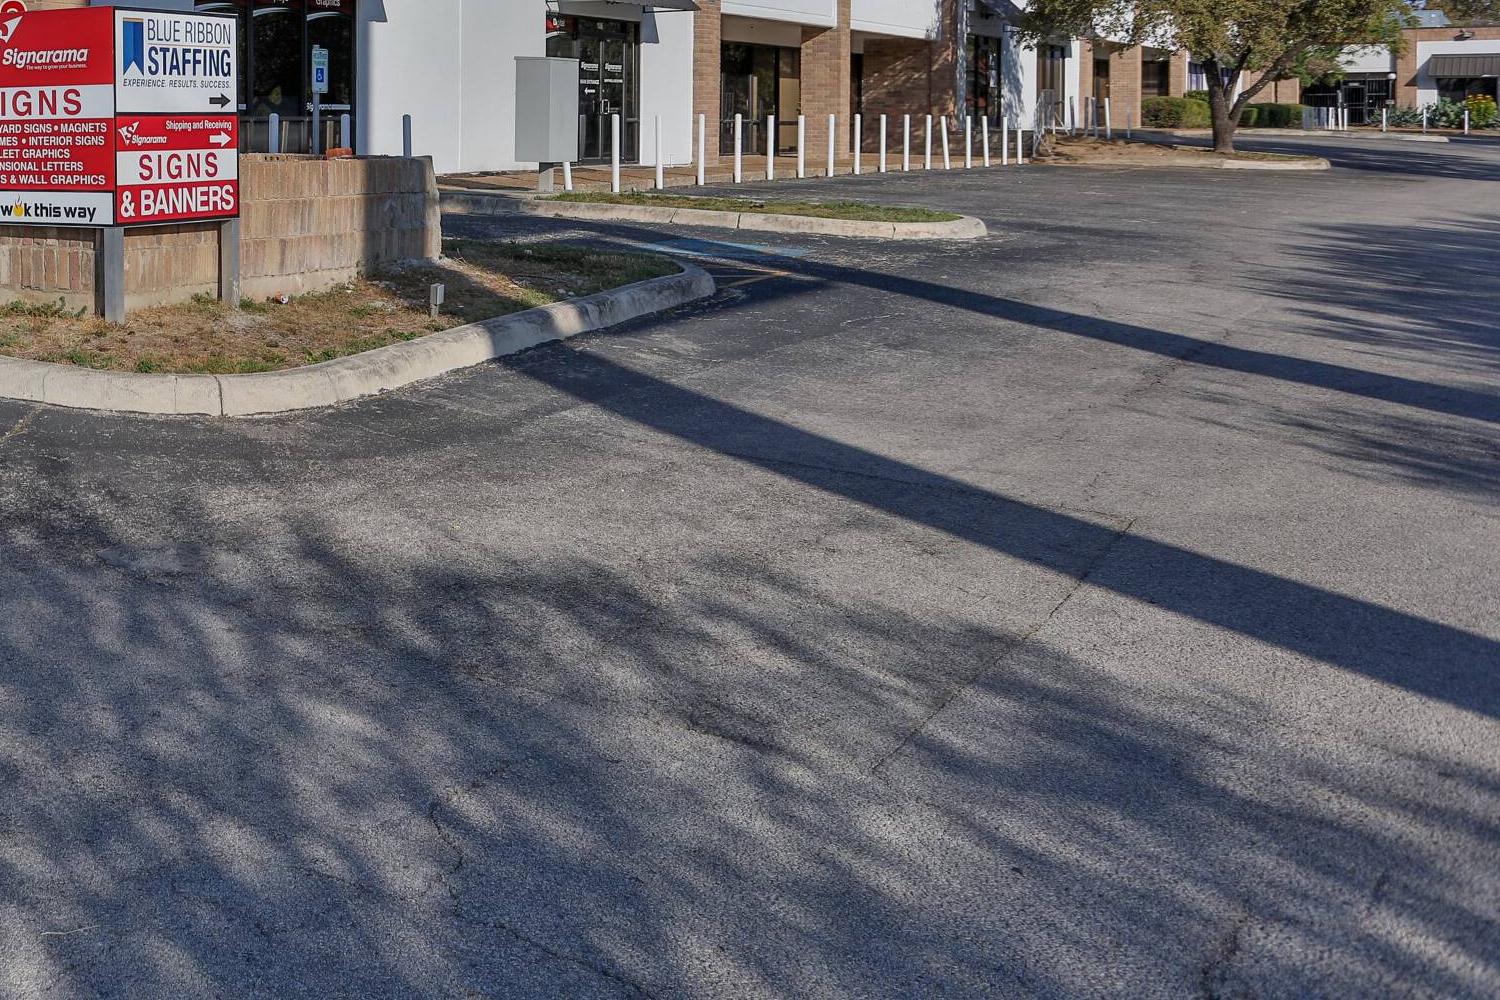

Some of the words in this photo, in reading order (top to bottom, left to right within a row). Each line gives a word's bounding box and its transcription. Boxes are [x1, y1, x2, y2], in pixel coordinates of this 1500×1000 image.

[147, 19, 180, 42] BLUE
[185, 21, 231, 44] RIBBON
[2, 48, 89, 68] Signarama
[148, 46, 231, 77] STAFFING
[169, 80, 199, 88] RESULTS.
[200, 80, 231, 89] SUCCESS.
[24, 123, 52, 133] SIGNS
[61, 123, 107, 133] MAGNETS
[166, 120, 192, 131] Shipping
[192, 121, 204, 130] and
[204, 121, 232, 131] Receiving
[29, 136, 72, 146] INTERIOR
[75, 136, 104, 146] SIGNS
[131, 134, 167, 146] Signarama
[22, 149, 70, 158] GRAPHICS
[41, 162, 84, 171] LETTERS
[139, 152, 218, 181] SIGNS
[10, 174, 17, 184] &
[18, 174, 48, 184] WALL
[50, 175, 106, 185] GRAPHICS
[120, 191, 136, 218] &
[140, 184, 234, 217] BANNERS
[34, 203, 61, 218] this
[64, 206, 96, 222] way
